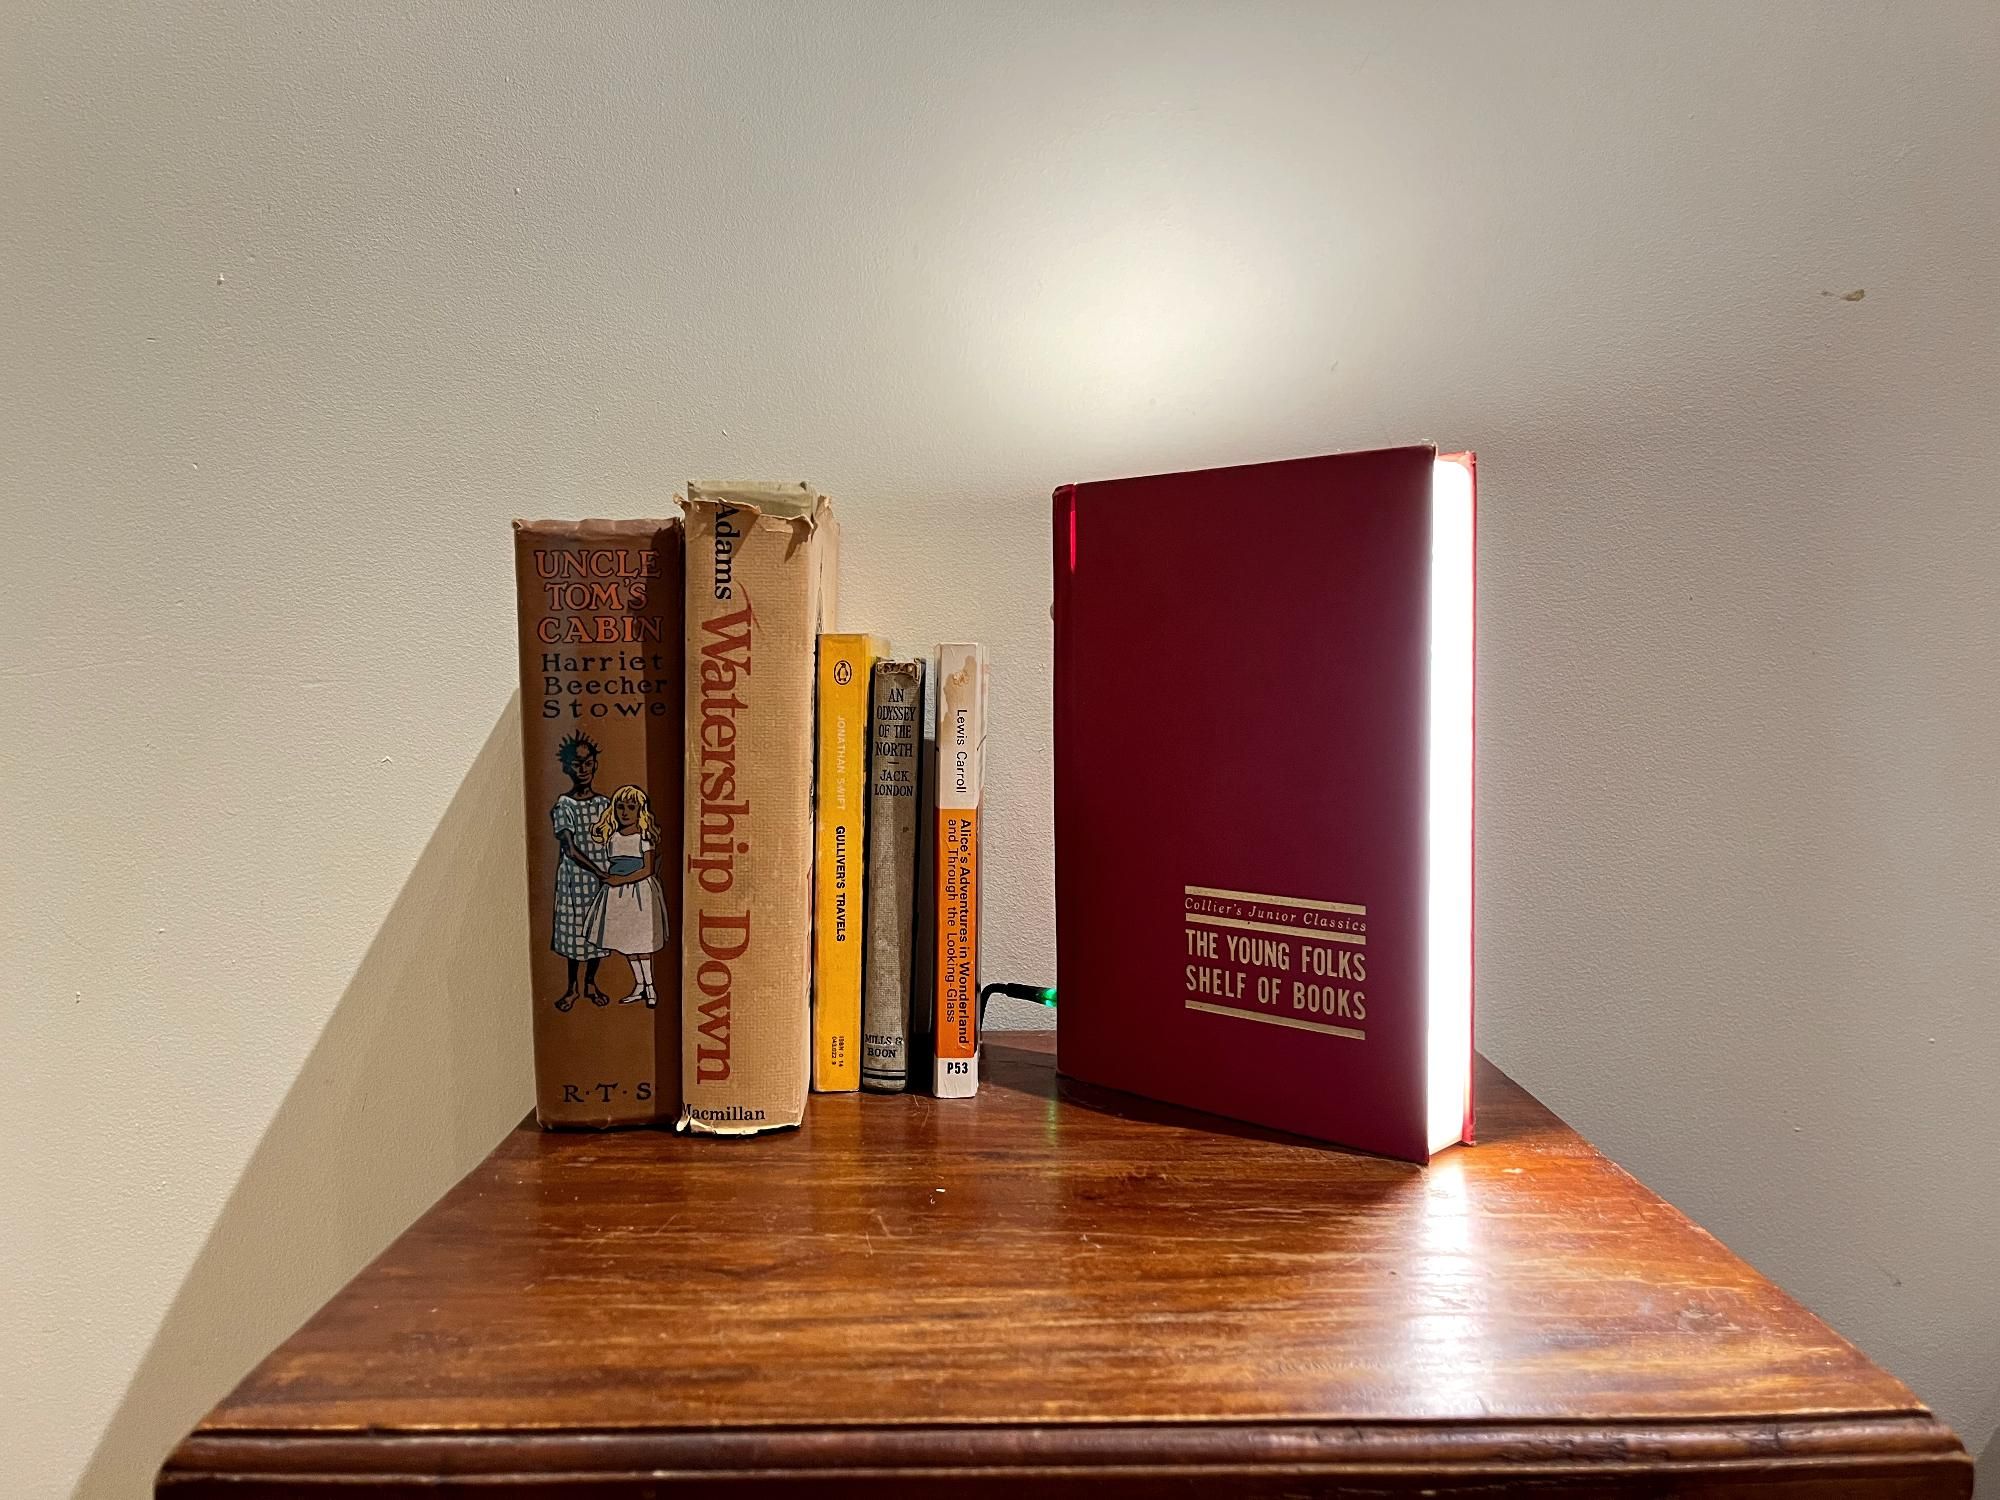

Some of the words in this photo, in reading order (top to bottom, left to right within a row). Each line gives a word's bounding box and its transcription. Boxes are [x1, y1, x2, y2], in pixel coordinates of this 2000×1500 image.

[534, 549, 662, 579] UNCLE
[714, 503, 741, 600] Adams
[544, 579, 648, 611] TOM'S
[537, 615, 664, 643] CABIN
[542, 651, 664, 672] Harriet
[544, 676, 667, 696] Beecher
[888, 688, 904, 703] AN
[542, 699, 666, 719] Stowe
[876, 705, 917, 722] ODYSSEY
[688, 581, 760, 893] Watership
[878, 724, 891, 739] OF
[894, 724, 912, 739] THE
[956, 709, 968, 746] Lewis
[836, 715, 847, 774] JONATHAN
[875, 742, 913, 758] NORTH
[880, 770, 909, 782] JACK
[956, 751, 968, 793] Carroll
[836, 778, 846, 811] SWIFT
[874, 784, 913, 797] LONDON
[947, 819, 958, 842] and
[960, 819, 972, 864] Alice's
[835, 825, 846, 889] GULLIVER'S
[945, 847, 958, 901] Through
[835, 893, 846, 942] TRAVELS
[947, 906, 958, 926] the
[959, 866, 971, 942] Adventures
[1184, 897, 1242, 917] Collier's
[1248, 906, 1297, 923] Junior
[1303, 912, 1367, 932] Classics
[959, 947, 970, 959] in
[1185, 928, 1219, 960] THE
[1226, 933, 1290, 971] YOUNG
[1301, 945, 1367, 982] FOLKS
[944, 933, 957, 1023] Looking-Glass
[1185, 964, 1247, 999] SHELF
[1257, 976, 1282, 1005] OF
[1293, 981, 1367, 1021] BOOKS
[696, 909, 751, 1085] Down
[958, 962, 970, 1044] Wonderland
[865, 1034, 892, 1046] MILLS
[895, 1035, 903, 1045] &
[867, 1047, 897, 1058] BOON
[947, 1062, 969, 1075] P53
[682, 1103, 766, 1121] Macmillan
